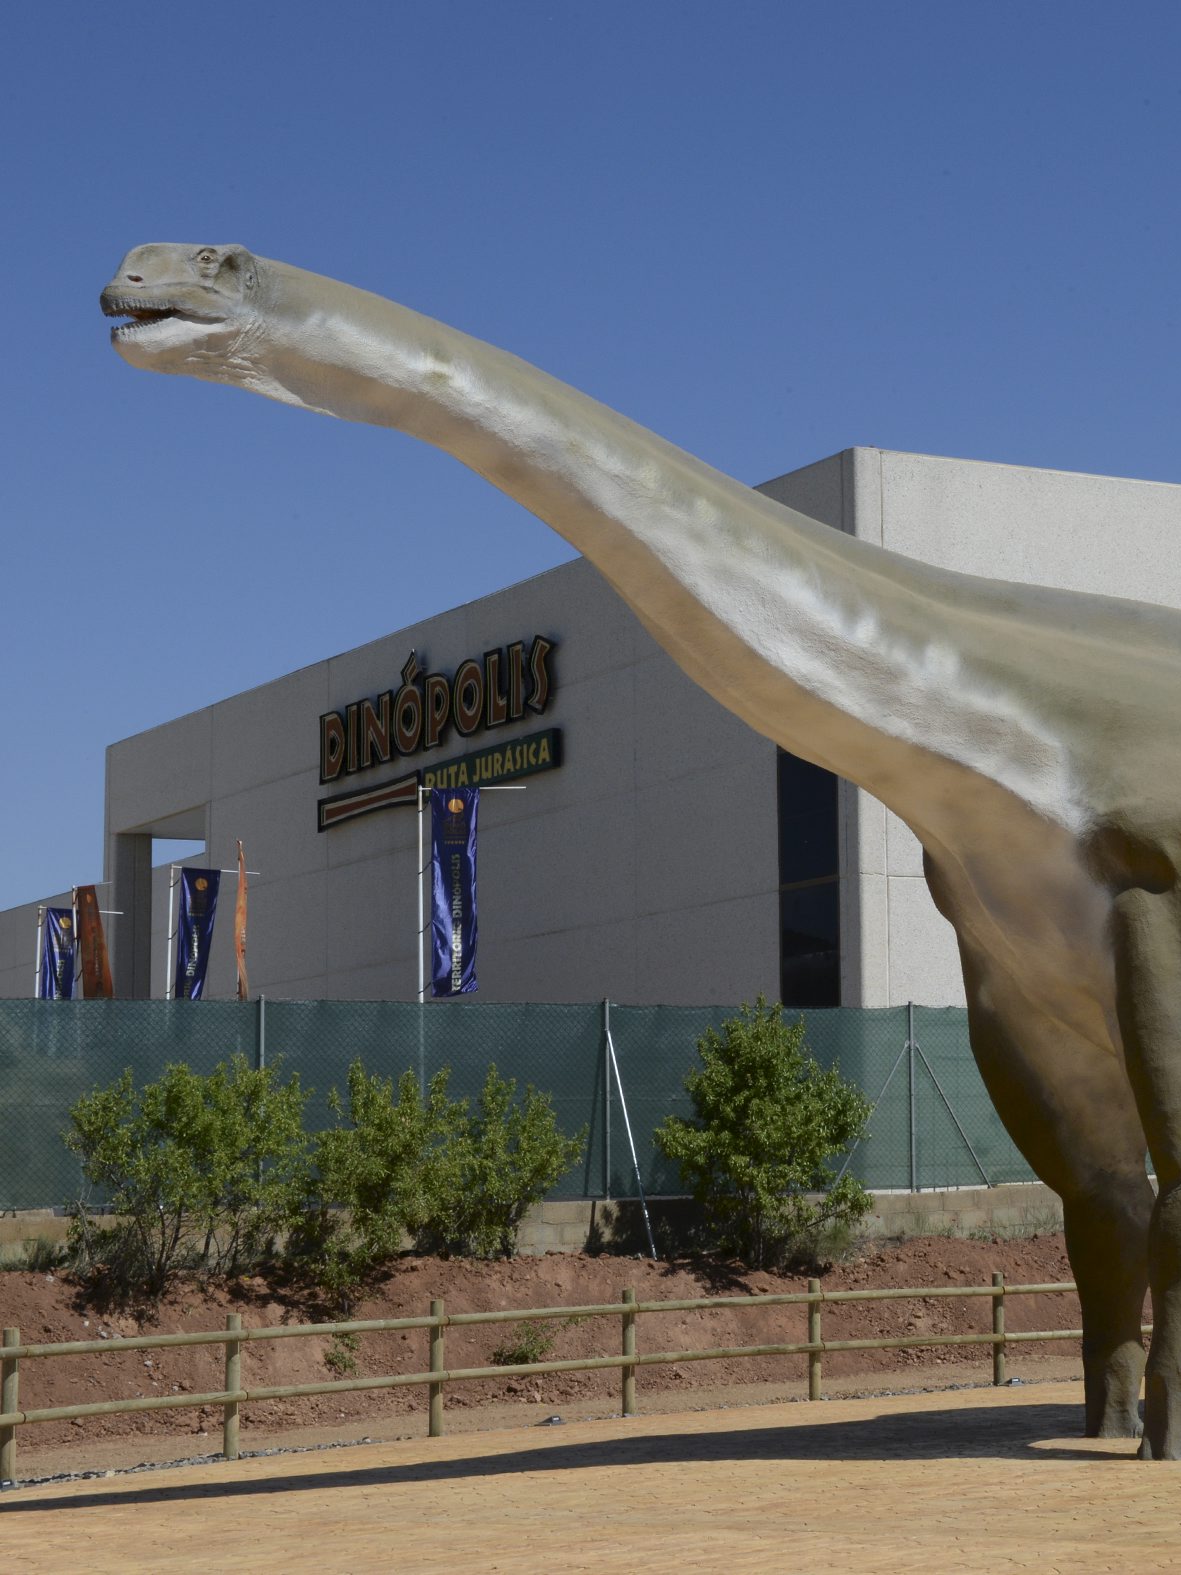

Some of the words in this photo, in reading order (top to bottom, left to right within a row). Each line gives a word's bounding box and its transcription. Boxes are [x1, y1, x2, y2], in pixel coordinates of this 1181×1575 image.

[319, 635, 556, 785] DINÓPOLIS
[424, 762, 468, 797] RUTA
[473, 737, 550, 783] JURÁSICA
